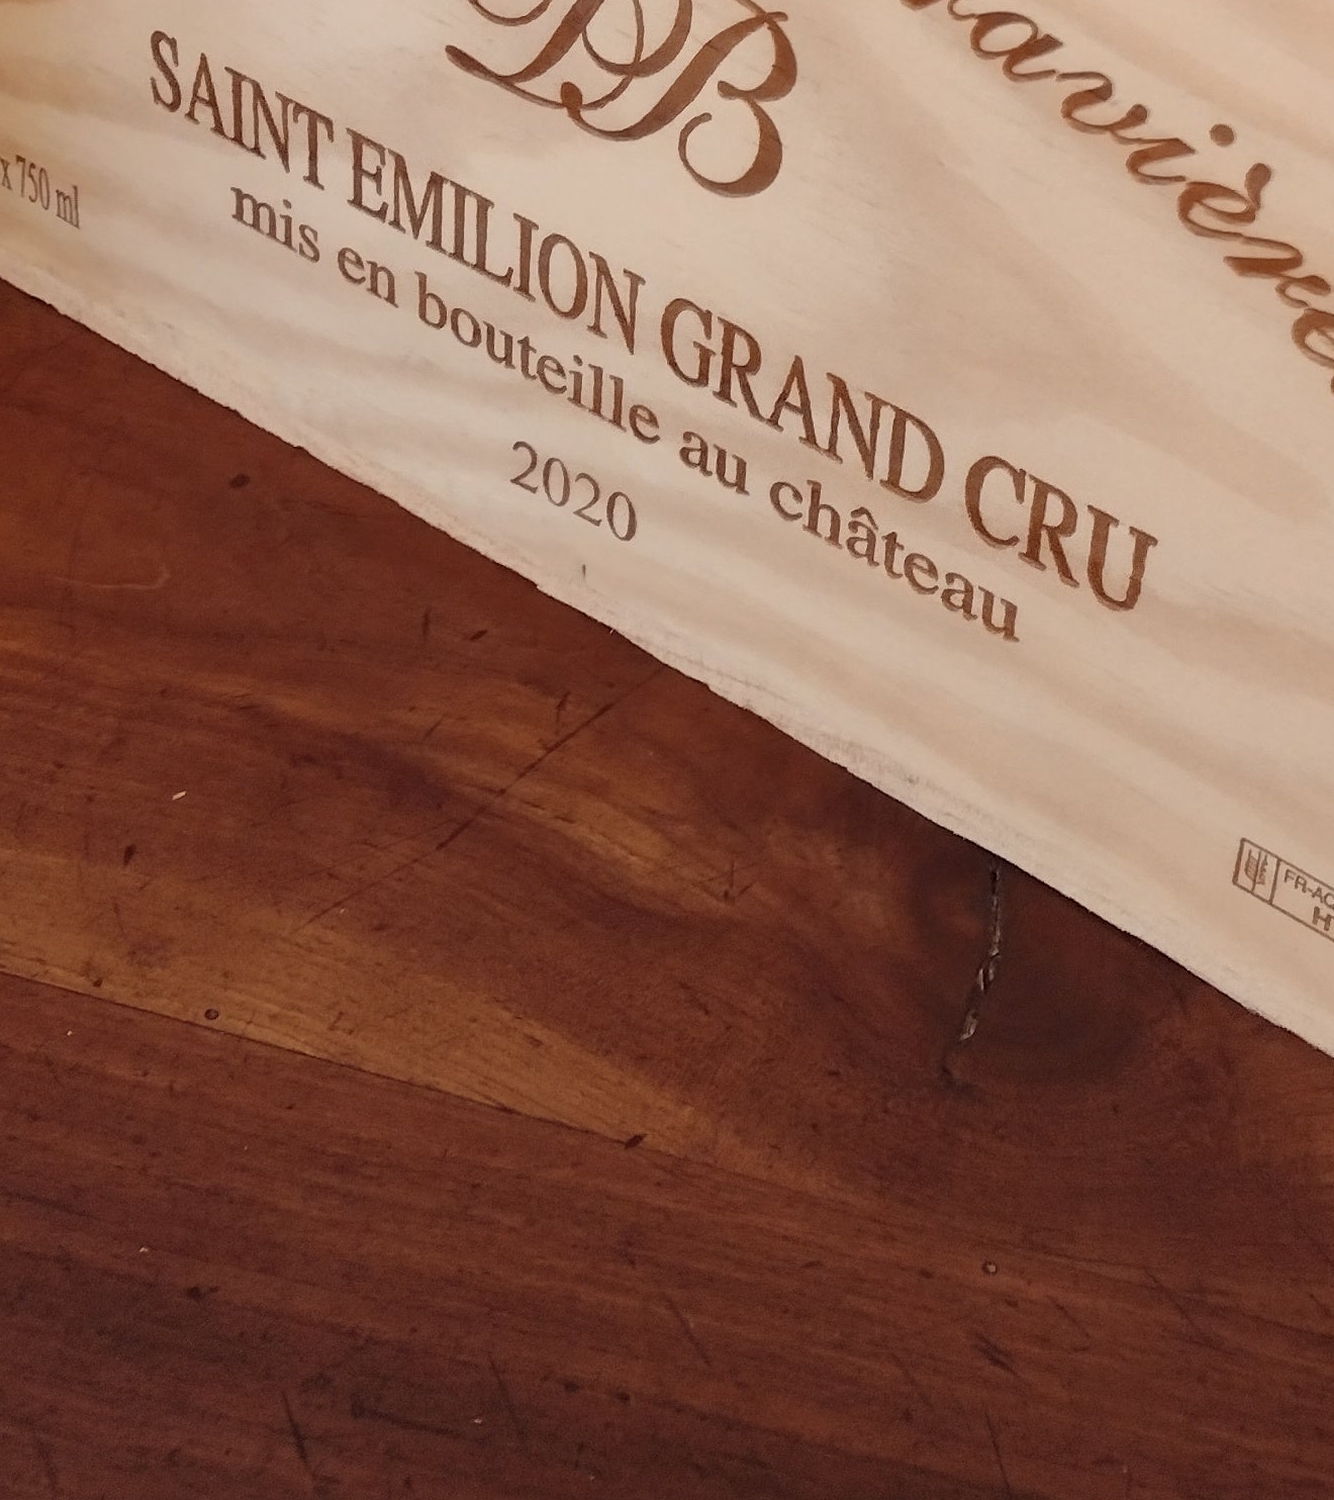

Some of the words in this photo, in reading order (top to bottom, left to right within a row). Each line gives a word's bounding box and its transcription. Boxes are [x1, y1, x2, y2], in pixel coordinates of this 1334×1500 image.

[0, 156, 12, 191] x
[16, 154, 50, 210] 750
[55, 185, 80, 229] ml
[149, 29, 335, 190] SAINT
[344, 127, 646, 355] EMILION
[660, 297, 945, 502] GRAND
[964, 454, 1158, 613] CRU
[230, 186, 320, 264] mis
[337, 246, 399, 308] en
[415, 270, 661, 445] bouteille
[679, 428, 750, 496] au
[769, 479, 1020, 642] château
[510, 440, 639, 542] 2020
